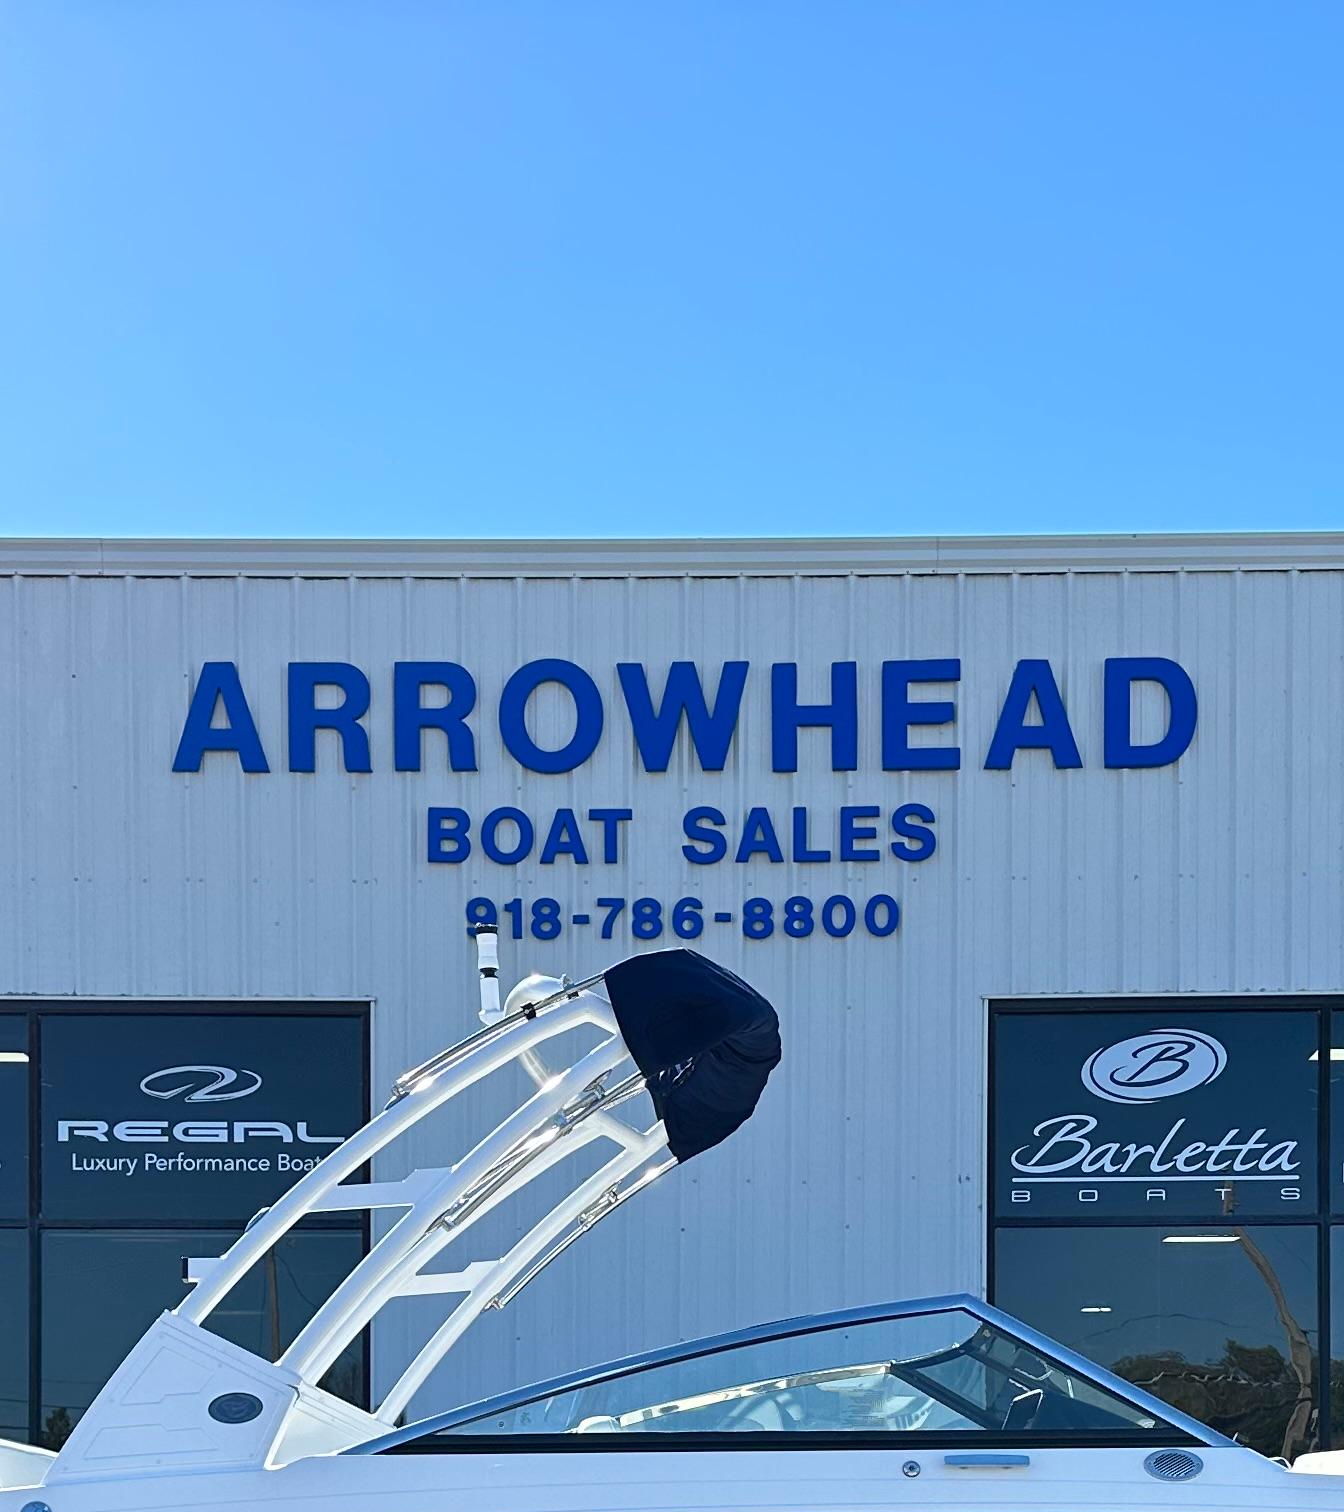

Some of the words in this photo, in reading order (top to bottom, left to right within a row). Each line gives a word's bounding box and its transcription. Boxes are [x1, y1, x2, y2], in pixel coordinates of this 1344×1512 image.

[172, 656, 1198, 774] ARROWHEAD
[427, 806, 632, 865] BOAT
[681, 803, 938, 865] SALES
[465, 894, 901, 941] 918-786-8800
[57, 1120, 346, 1143] REGAL
[1010, 1114, 1301, 1174] Barletta
[71, 1153, 137, 1176] Luxury
[145, 1152, 270, 1172] Performance
[1011, 1187, 1301, 1203] BOATS
